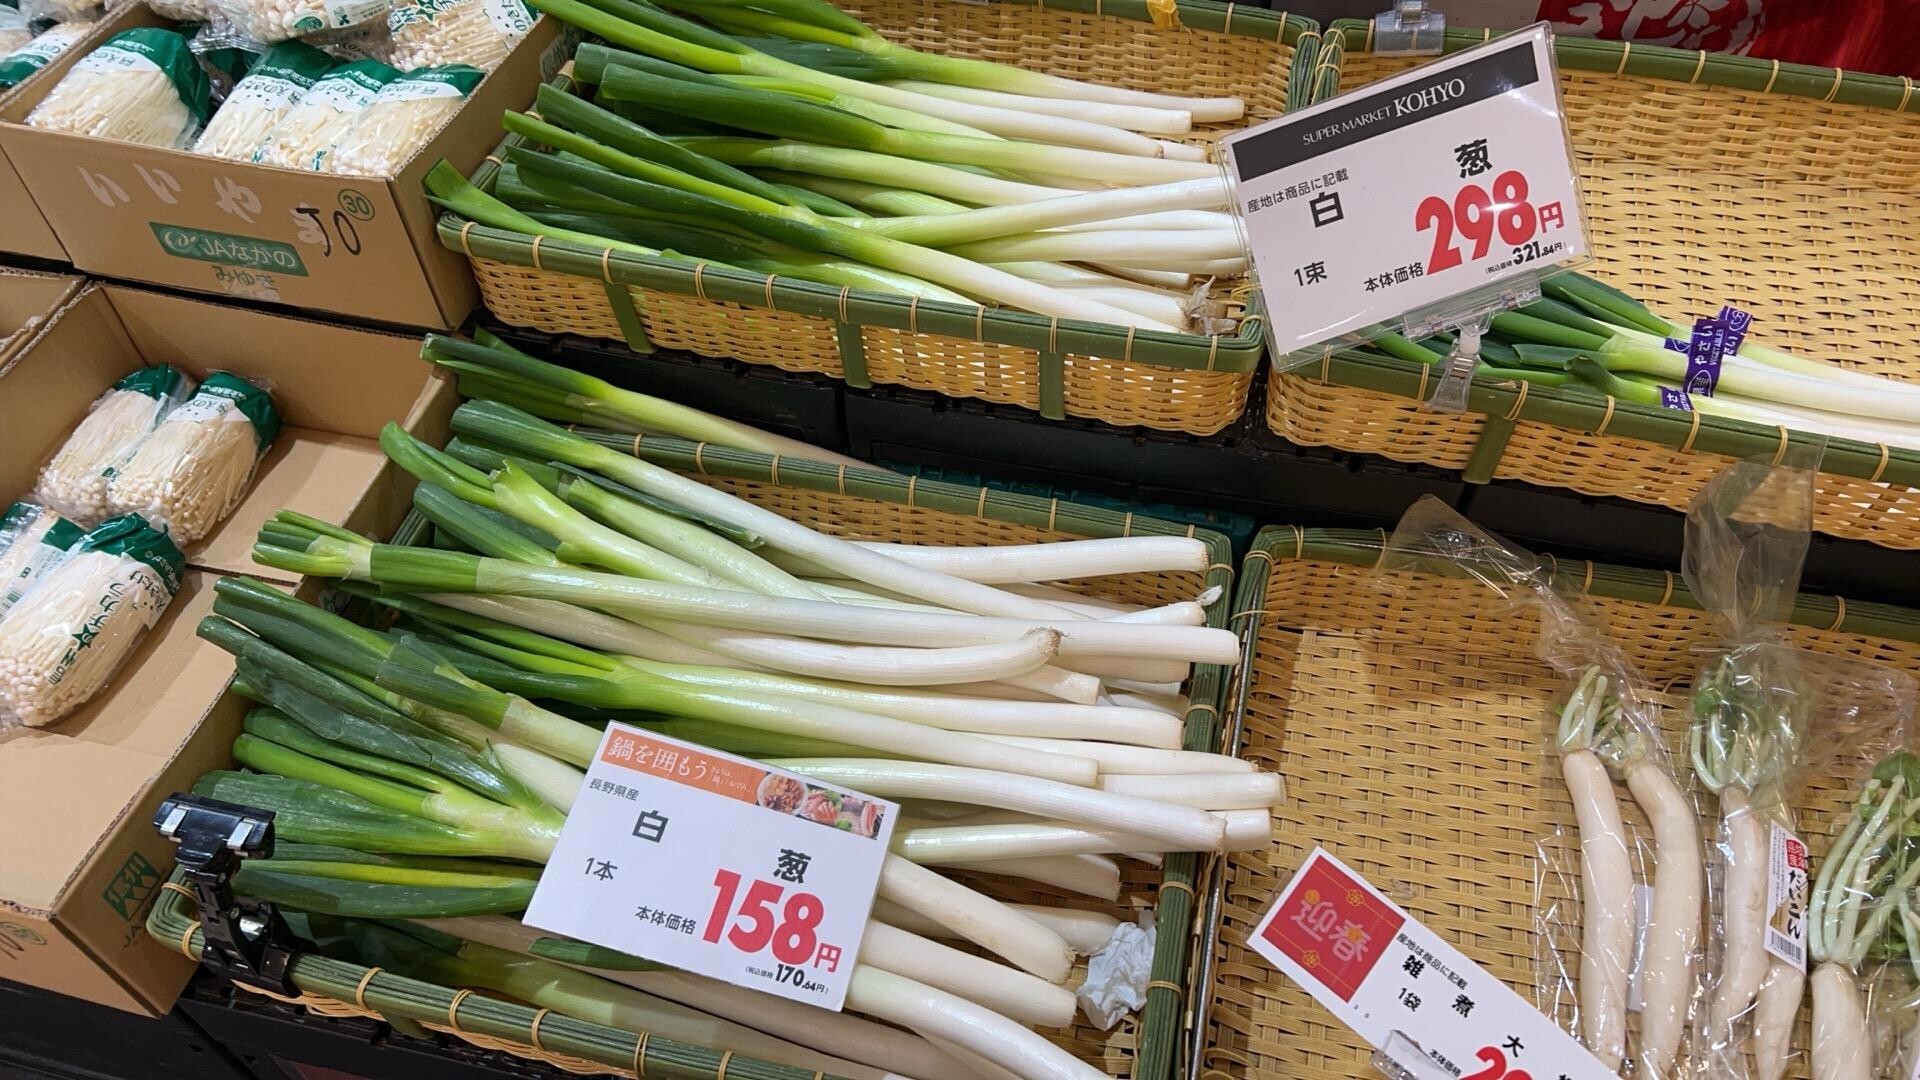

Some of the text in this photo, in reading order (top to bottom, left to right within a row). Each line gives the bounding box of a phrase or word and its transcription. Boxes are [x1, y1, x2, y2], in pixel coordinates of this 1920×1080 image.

[1302, 78, 1465, 146] SUPER MARKET KOHYO
[1247, 168, 1350, 214] 産地は商品に記載
[1309, 138, 1493, 228] 白 葱
[342, 193, 371, 216] 30
[1293, 260, 1328, 287] 1束
[1363, 262, 1424, 293] 本体価格
[1694, 325, 1713, 366] やさい
[607, 736, 708, 780] 鍋を囲もう
[590, 777, 640, 802] 長野県産
[632, 809, 812, 884] 白 葱
[585, 857, 618, 881] 1本
[634, 905, 697, 935] 本体価格
[1787, 869, 1802, 940] だいこん
[1290, 899, 1372, 963] 迎春
[1396, 932, 1469, 992] 産地は商品に記載
[1397, 986, 1423, 1012] 1袋
[1401, 954, 1525, 1059] 雑 煮 大
[1428, 1047, 1463, 1077] 本体価格
